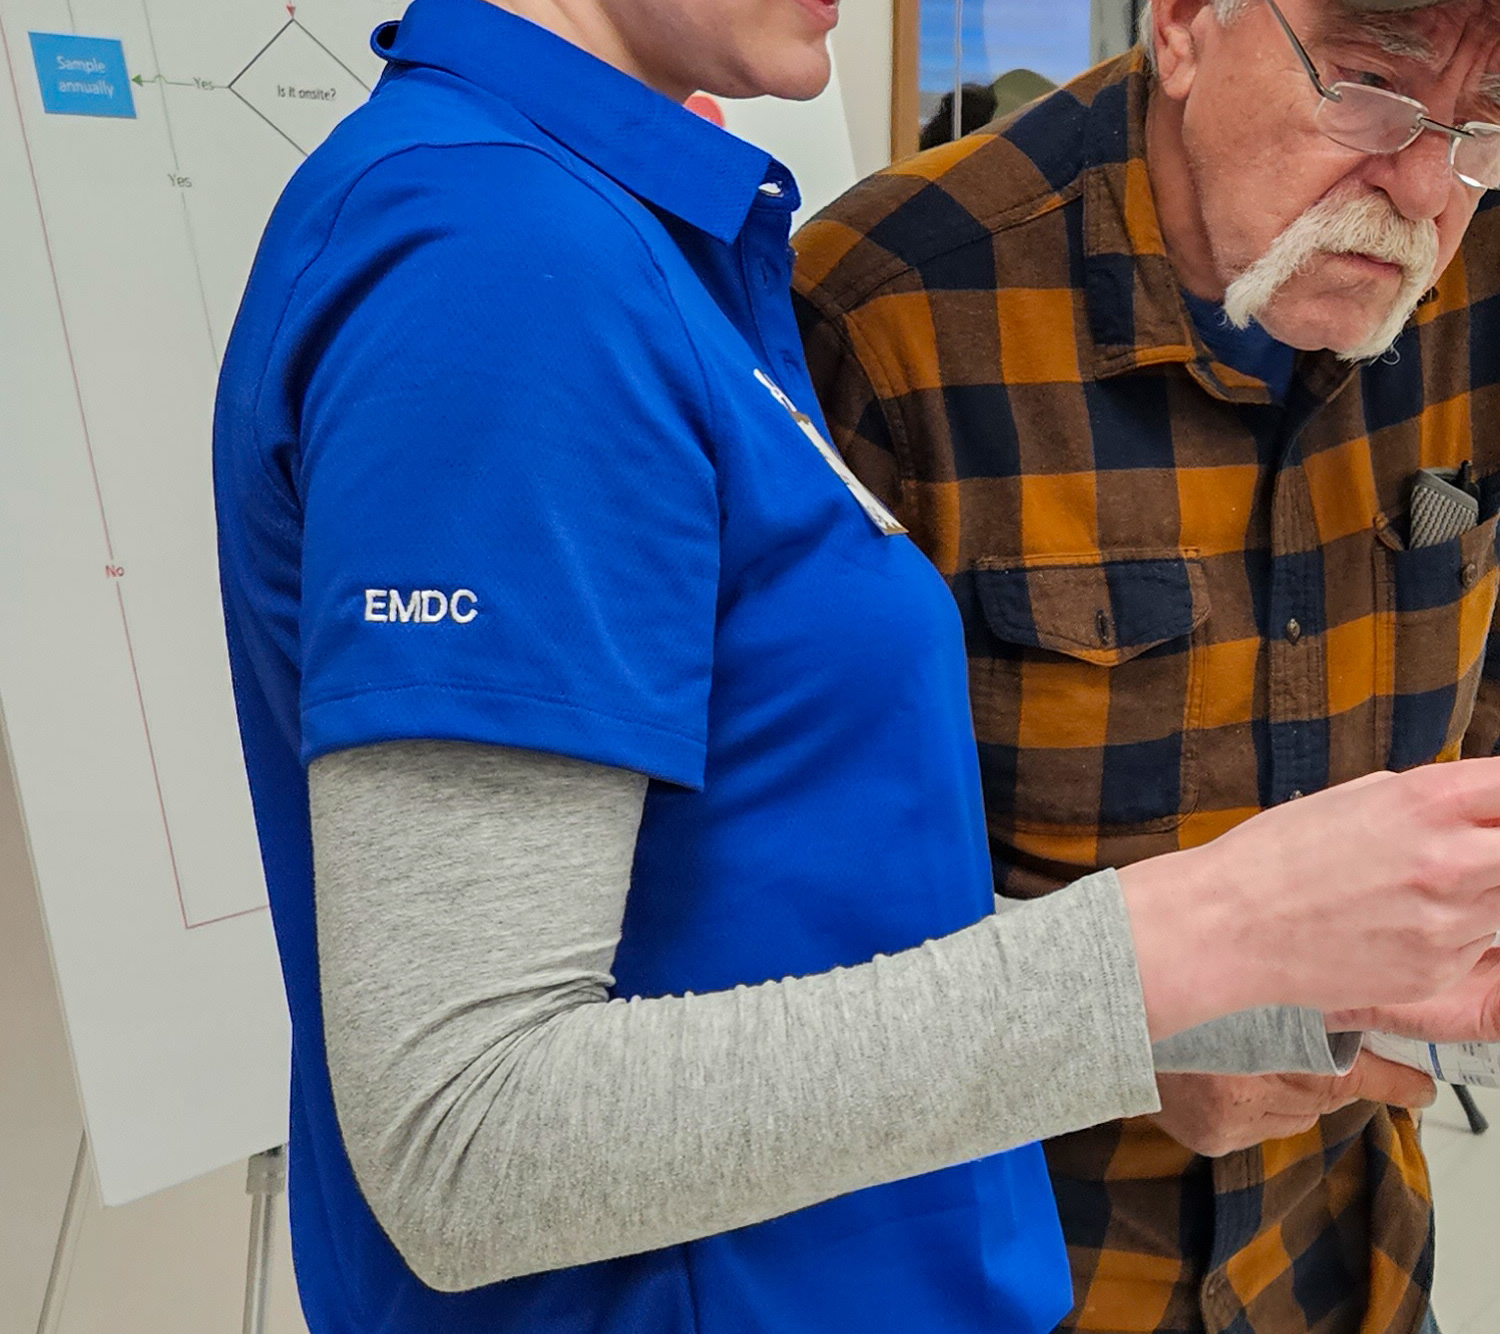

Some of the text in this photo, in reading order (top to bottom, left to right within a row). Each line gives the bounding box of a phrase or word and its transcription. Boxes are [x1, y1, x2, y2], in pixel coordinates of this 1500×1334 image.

[56, 55, 106, 74] Sample
[58, 78, 115, 99] annually
[192, 76, 215, 91] Yes
[277, 84, 337, 101] Is it onsite?
[167, 172, 193, 189] Yes
[104, 564, 125, 578] No
[364, 588, 478, 624] EMDC
